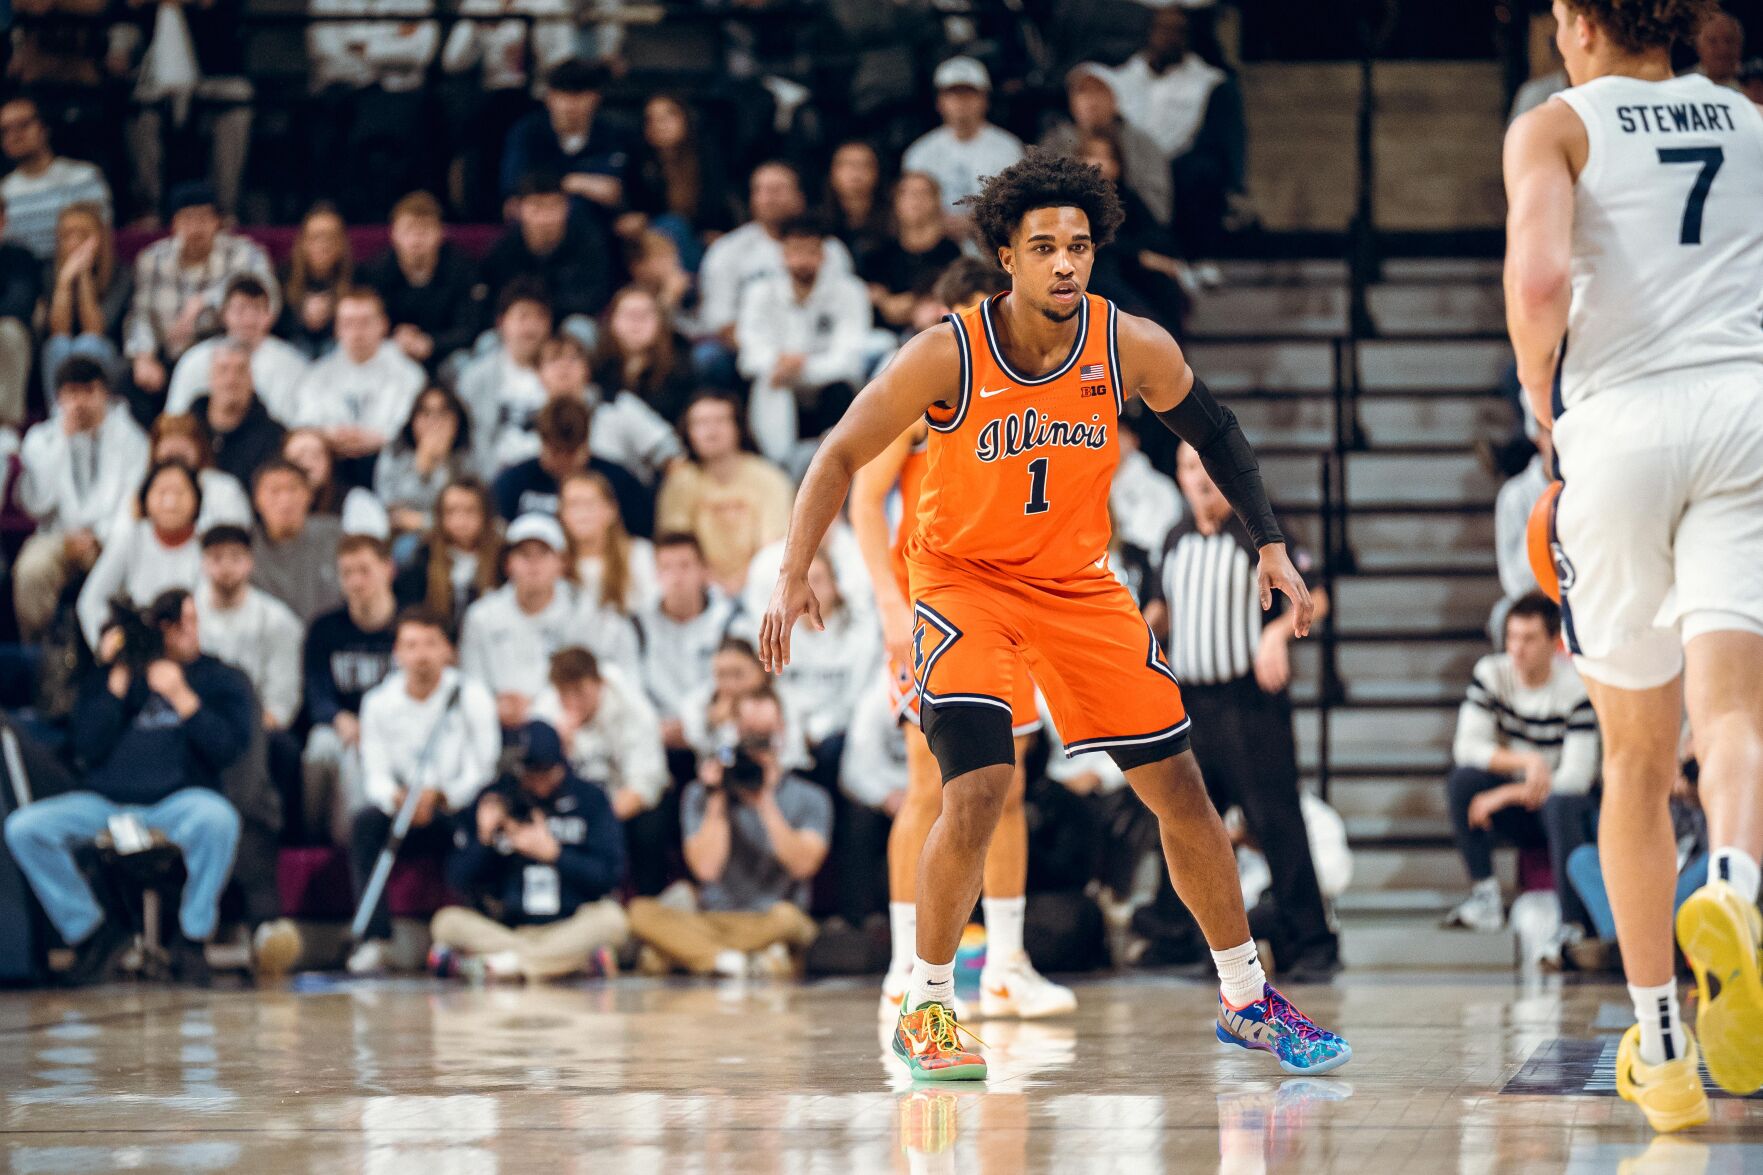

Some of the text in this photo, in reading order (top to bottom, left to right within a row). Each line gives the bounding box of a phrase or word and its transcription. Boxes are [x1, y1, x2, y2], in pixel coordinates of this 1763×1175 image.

[1616, 103, 1735, 133] STEWART
[1655, 145, 1725, 246] 7
[975, 407, 1107, 462] Illinois
[1024, 457, 1050, 515] 1
[1221, 1003, 1279, 1046] NIKE
